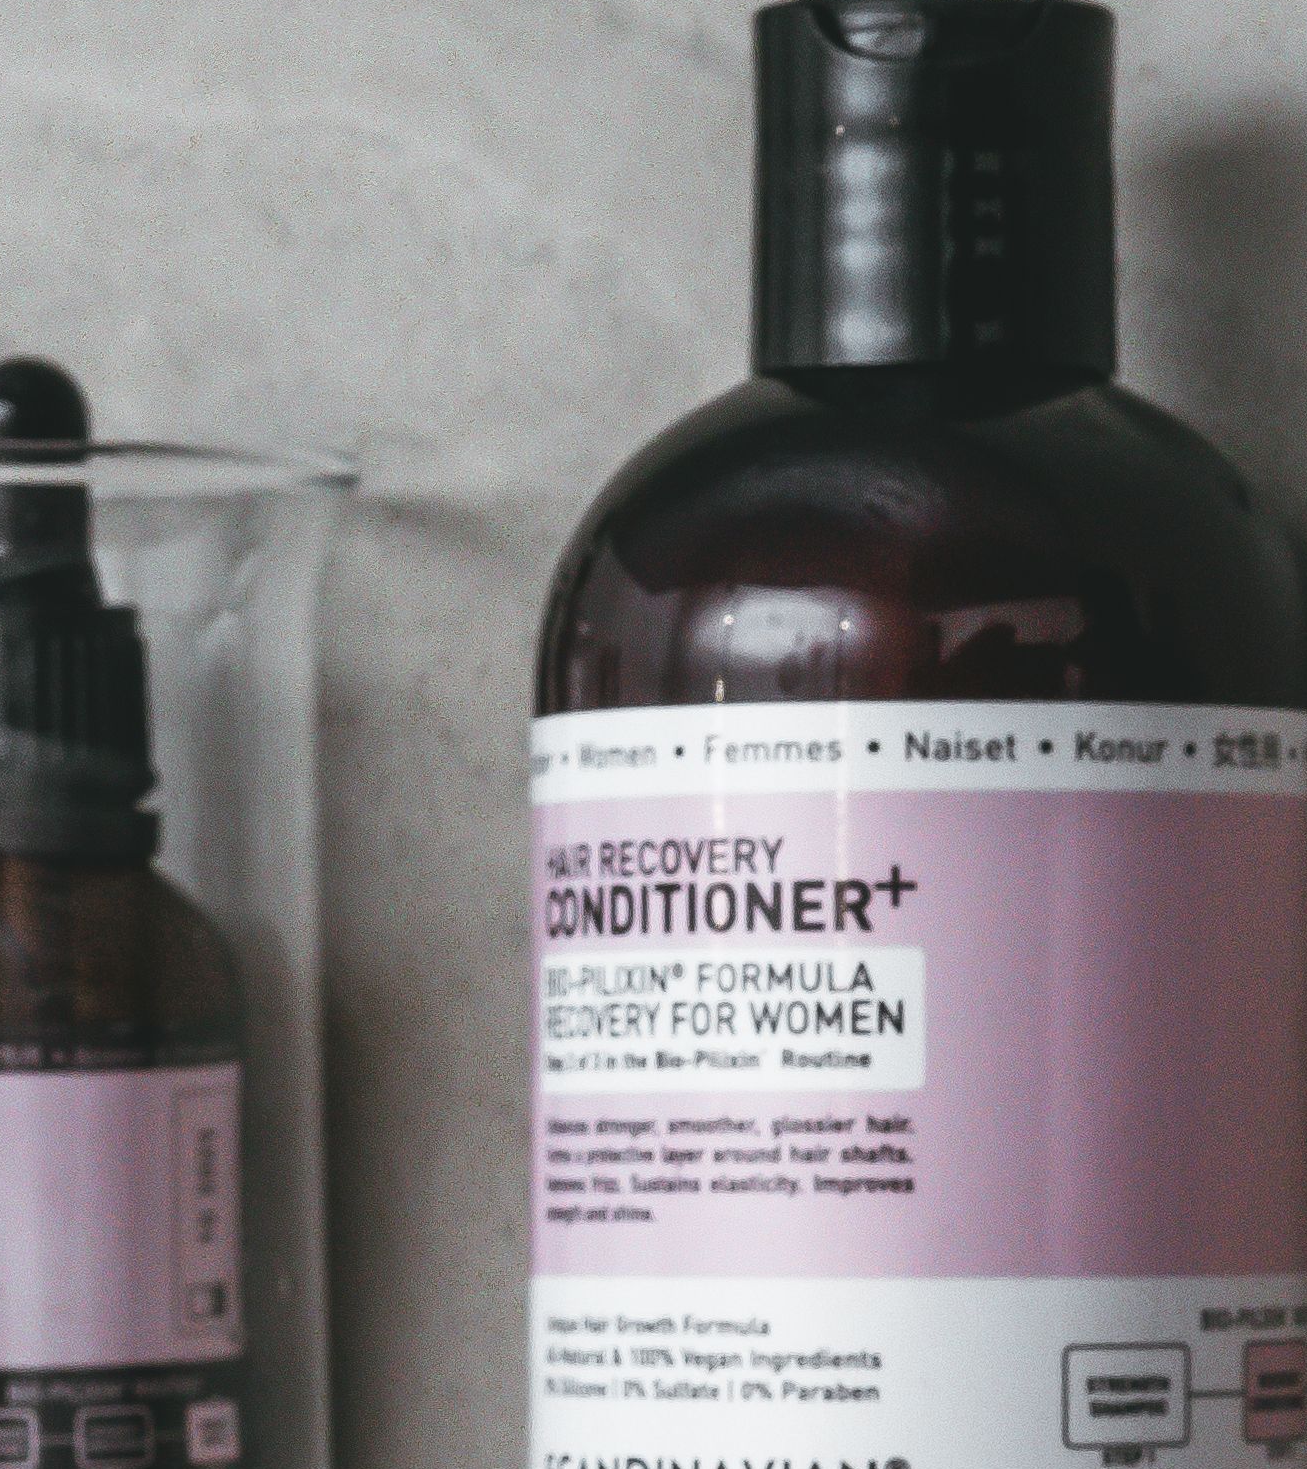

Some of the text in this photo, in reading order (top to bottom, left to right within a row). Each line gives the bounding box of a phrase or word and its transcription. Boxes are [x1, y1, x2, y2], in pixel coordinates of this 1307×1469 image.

[704, 733, 842, 764] Femmes
[905, 731, 1017, 762] Naiset
[1074, 731, 1168, 763] Konur
[599, 835, 784, 878] RECOVERY
[698, 961, 874, 993] FORMULA
[671, 1000, 736, 1036] FOR
[750, 998, 905, 1035] WOMEN
[682, 1313, 772, 1336] Formula
[684, 1348, 742, 1374] Vegan
[750, 1347, 882, 1374] Ingredients
[781, 1379, 881, 1402] Paraben
